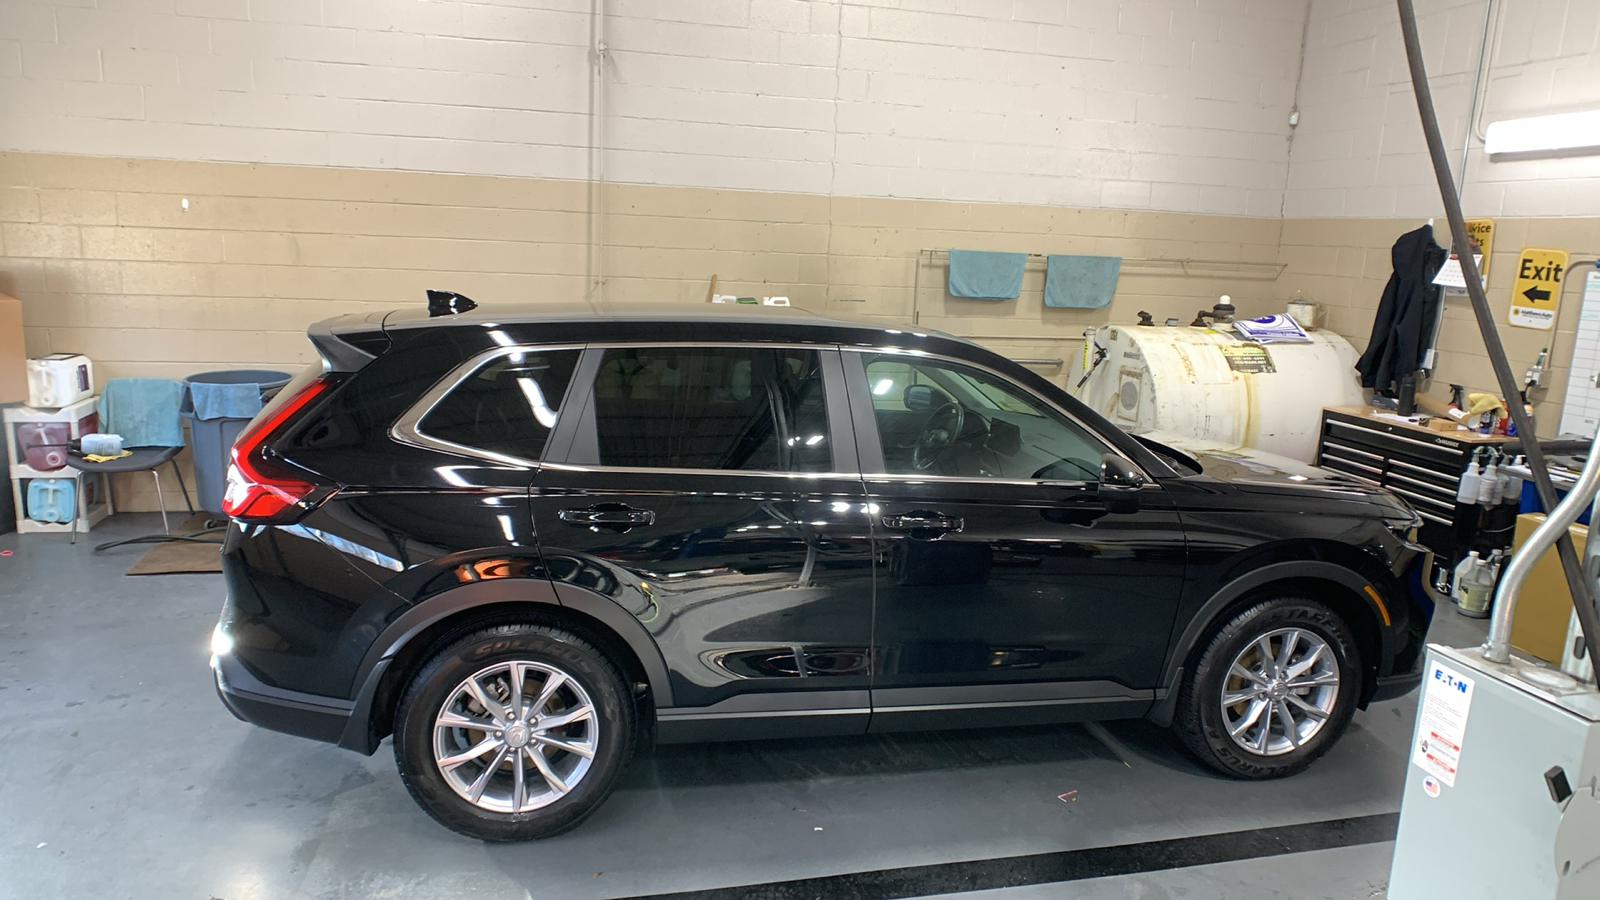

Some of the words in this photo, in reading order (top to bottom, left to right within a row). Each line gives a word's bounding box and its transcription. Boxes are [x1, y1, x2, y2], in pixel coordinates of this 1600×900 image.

[1519, 258, 1563, 283] Exit
[474, 639, 592, 673] SOLARUS
[1434, 668, 1468, 694] EATON
[1216, 747, 1303, 777] OLARUS
